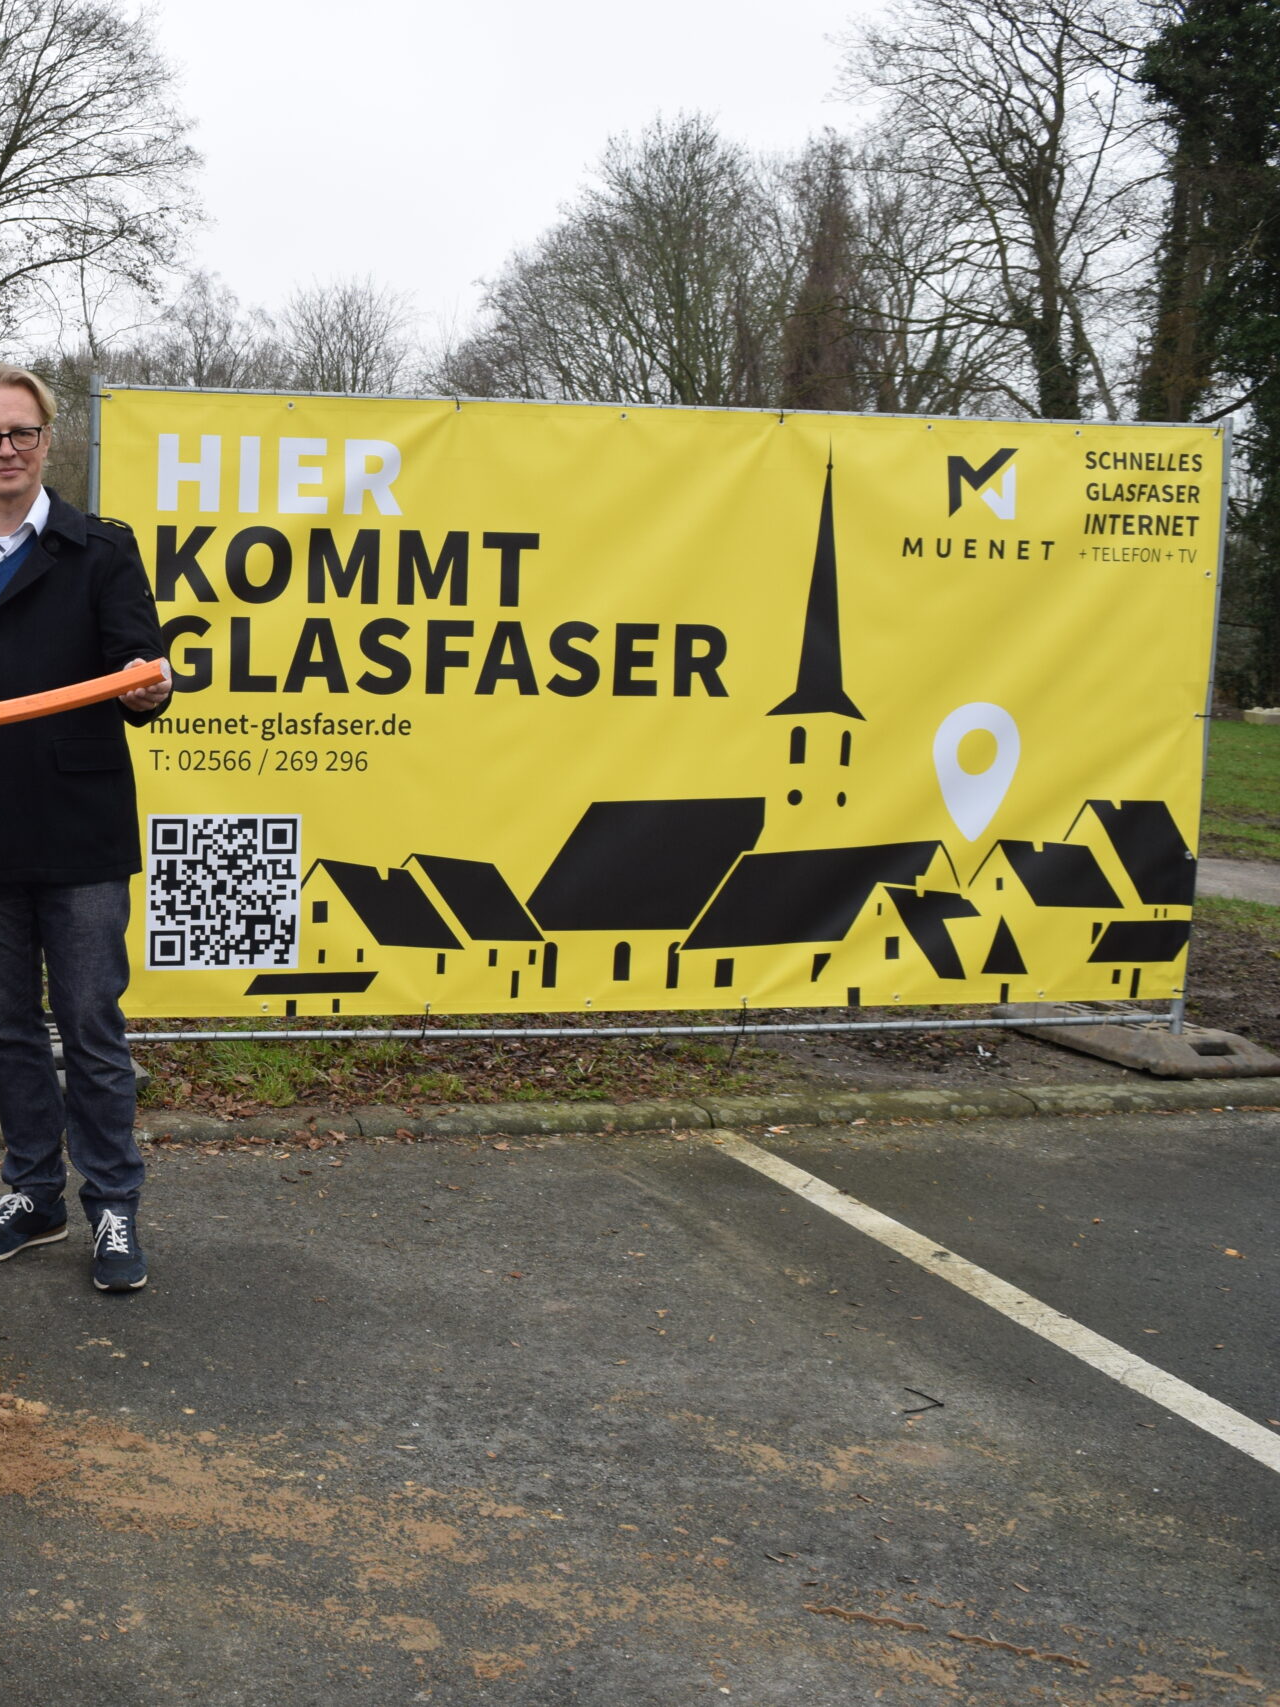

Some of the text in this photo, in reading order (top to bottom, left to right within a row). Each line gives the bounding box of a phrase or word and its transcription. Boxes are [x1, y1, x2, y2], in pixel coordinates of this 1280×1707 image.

[156, 433, 403, 516] HIER
[1085, 451, 1203, 472] SCHNELLES
[1086, 482, 1200, 503] GLASFASER
[1084, 513, 1200, 537] INTERNET
[902, 537, 1055, 560] MUENET
[1092, 547, 1161, 562] TELEFON
[1178, 548, 1198, 563] TV
[155, 525, 540, 608] KOMMT
[160, 615, 730, 698] GLASFASER
[149, 712, 412, 741] muenet-glasfaser.de
[149, 748, 369, 776] T: 02566 / 269 296
